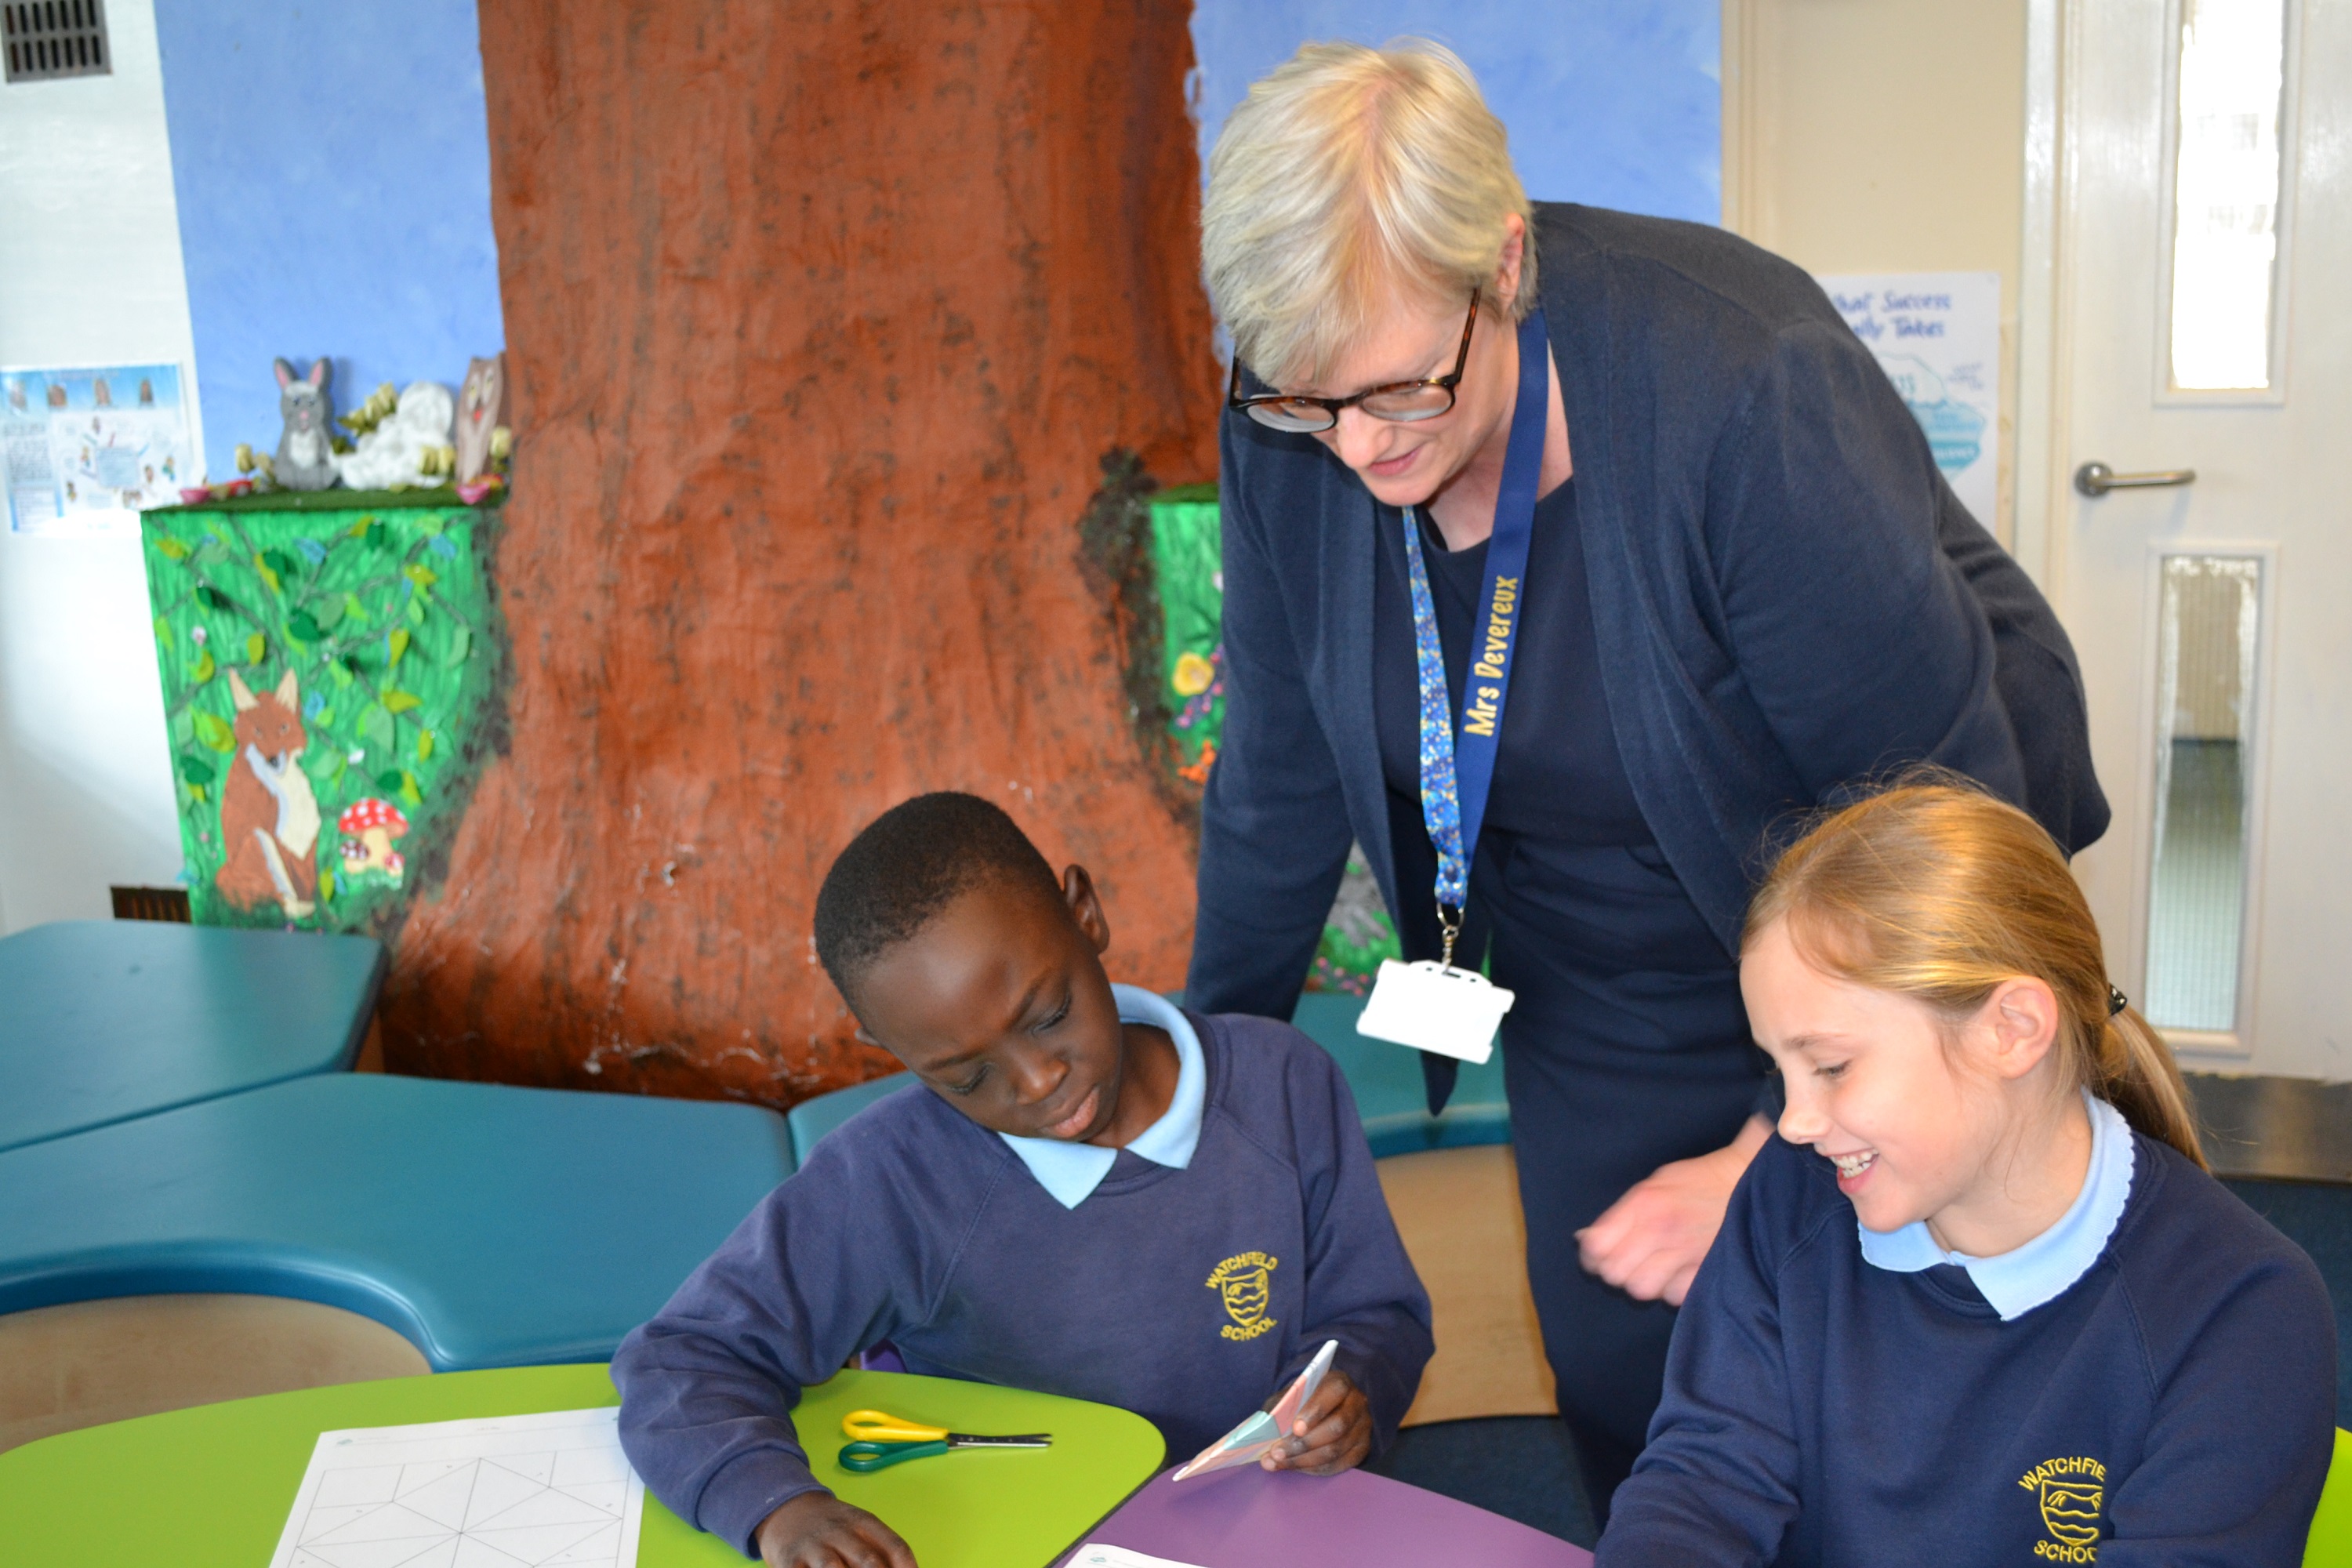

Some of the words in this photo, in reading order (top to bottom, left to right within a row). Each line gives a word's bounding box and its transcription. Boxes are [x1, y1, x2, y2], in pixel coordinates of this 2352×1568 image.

[1834, 292, 1875, 313] hat
[1882, 290, 1951, 312] Success
[1892, 317, 1944, 339] Takes
[1474, 575, 1518, 679] Devereux
[1464, 687, 1500, 737] Mrs
[1220, 1317, 1277, 1341] SCHOOL
[2018, 1457, 2107, 1491] WATCHFIE
